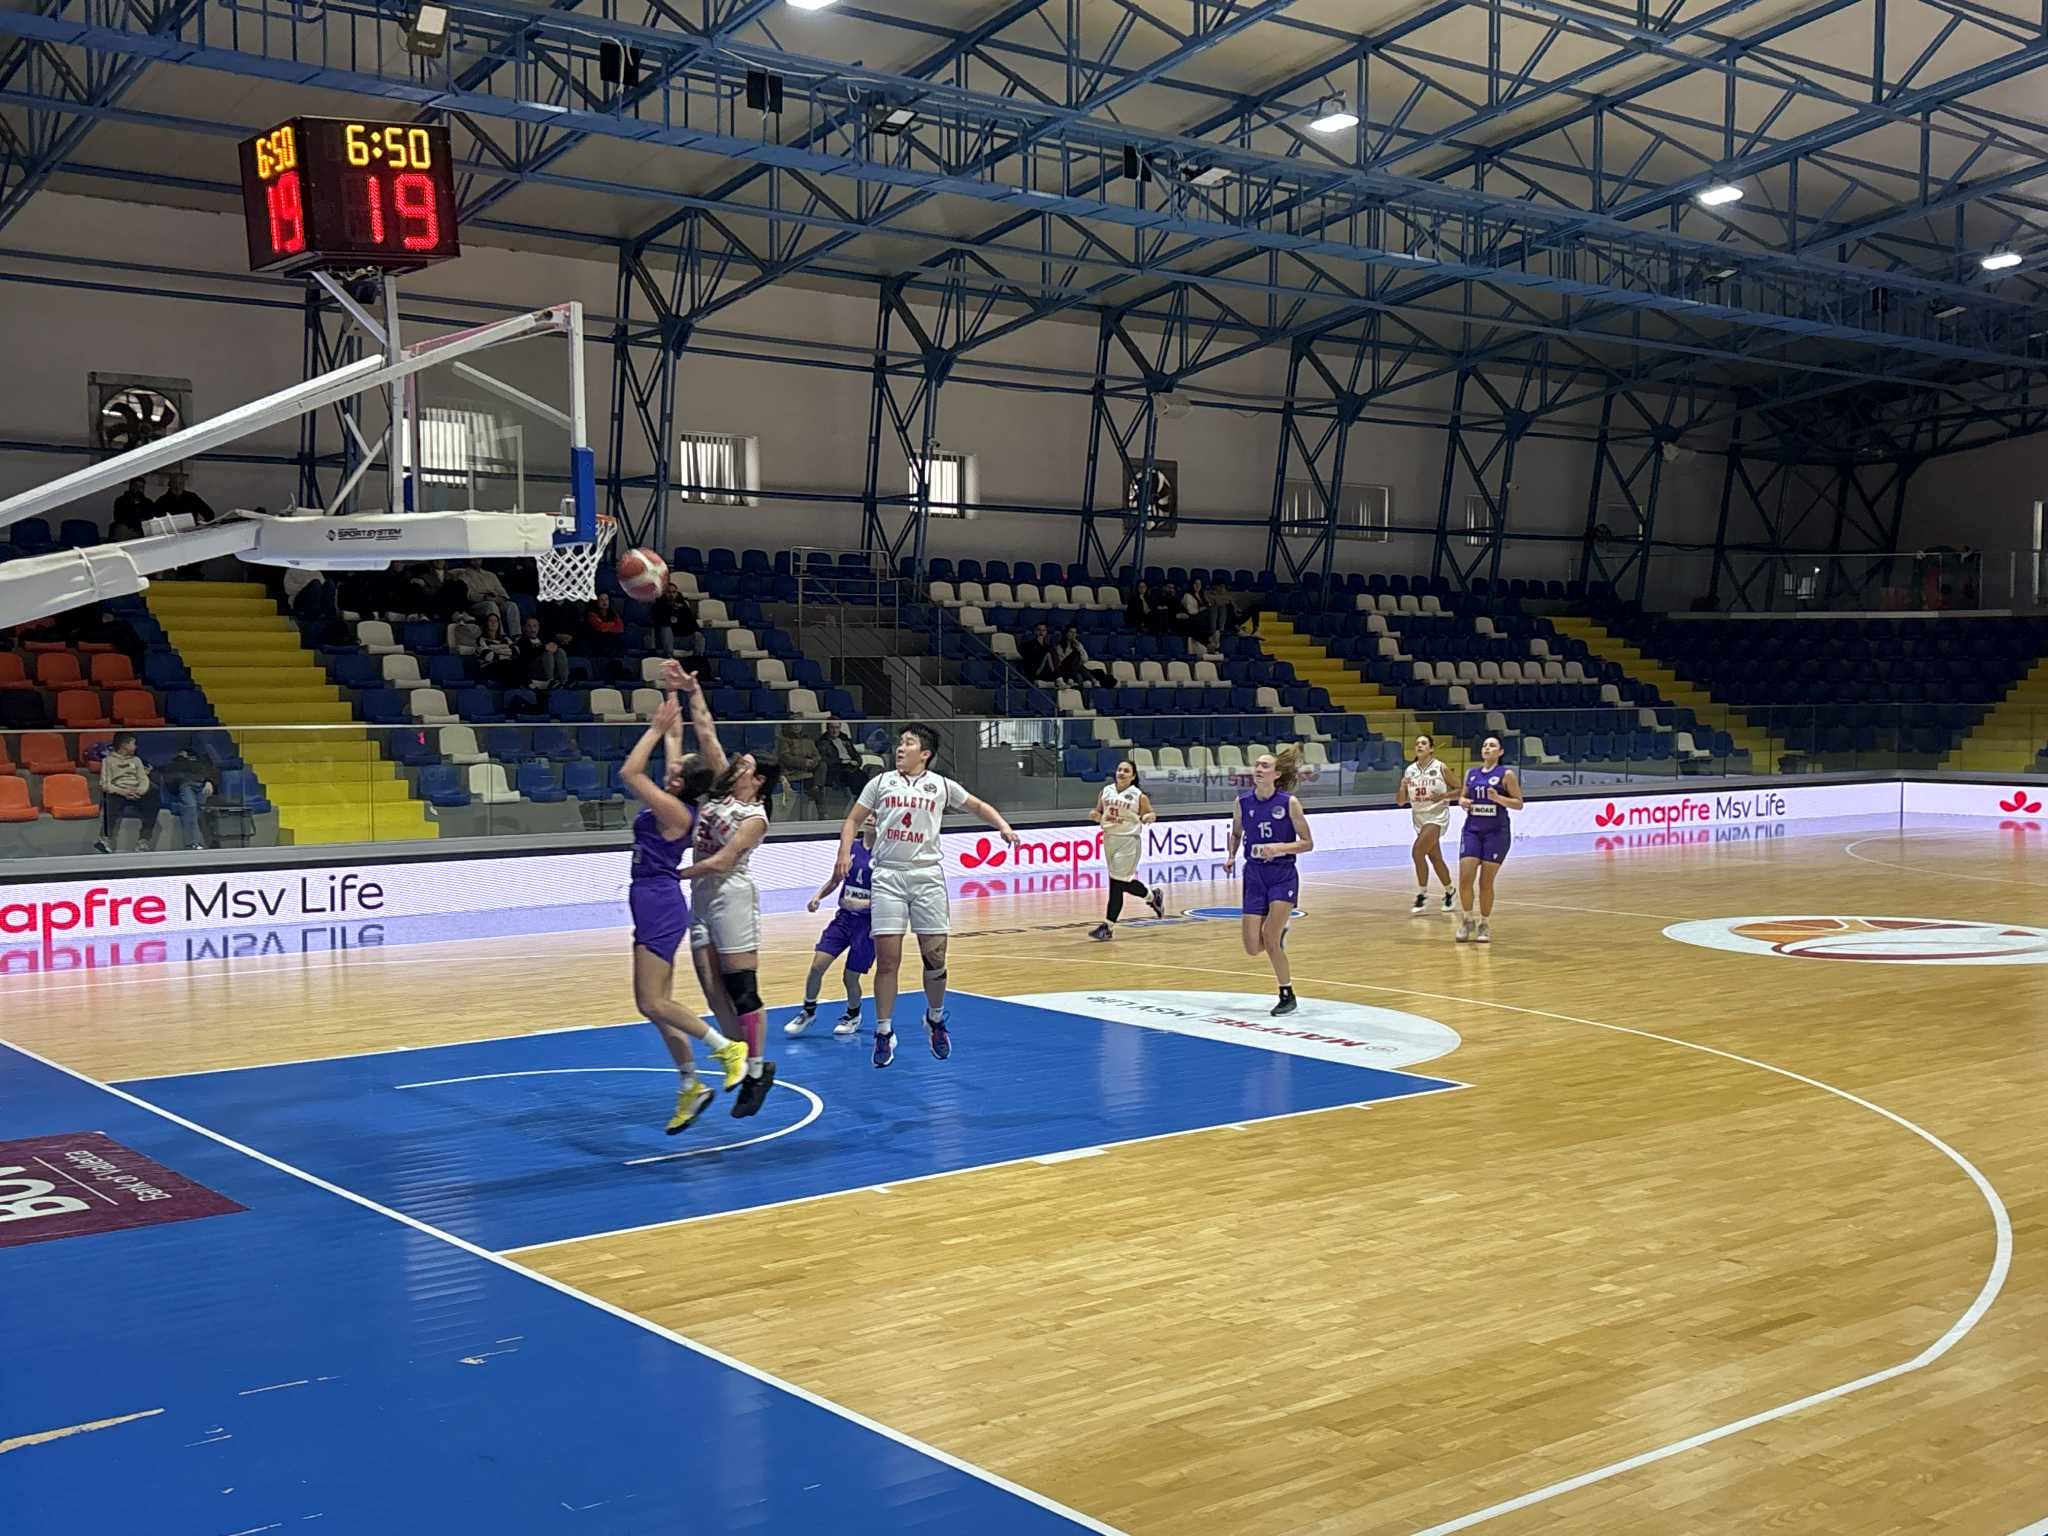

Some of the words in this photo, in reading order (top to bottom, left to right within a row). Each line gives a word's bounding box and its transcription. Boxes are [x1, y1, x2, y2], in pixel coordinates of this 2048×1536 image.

[256, 126, 297, 180] 6:50
[346, 124, 432, 170] 6:50
[368, 173, 439, 250] 19
[901, 812, 912, 828] 4
[1258, 822, 1273, 838] 15
[1629, 798, 1710, 830] mapfre
[1716, 796, 1752, 819] Msv
[1756, 793, 1785, 816] Life
[887, 828, 924, 844] DREAM
[1014, 831, 1104, 870] mapf
[1149, 827, 1203, 856] Msv
[1211, 824, 1231, 852] Li
[0, 888, 167, 940] apfre
[185, 881, 286, 921] Msv
[301, 873, 384, 914] Life
